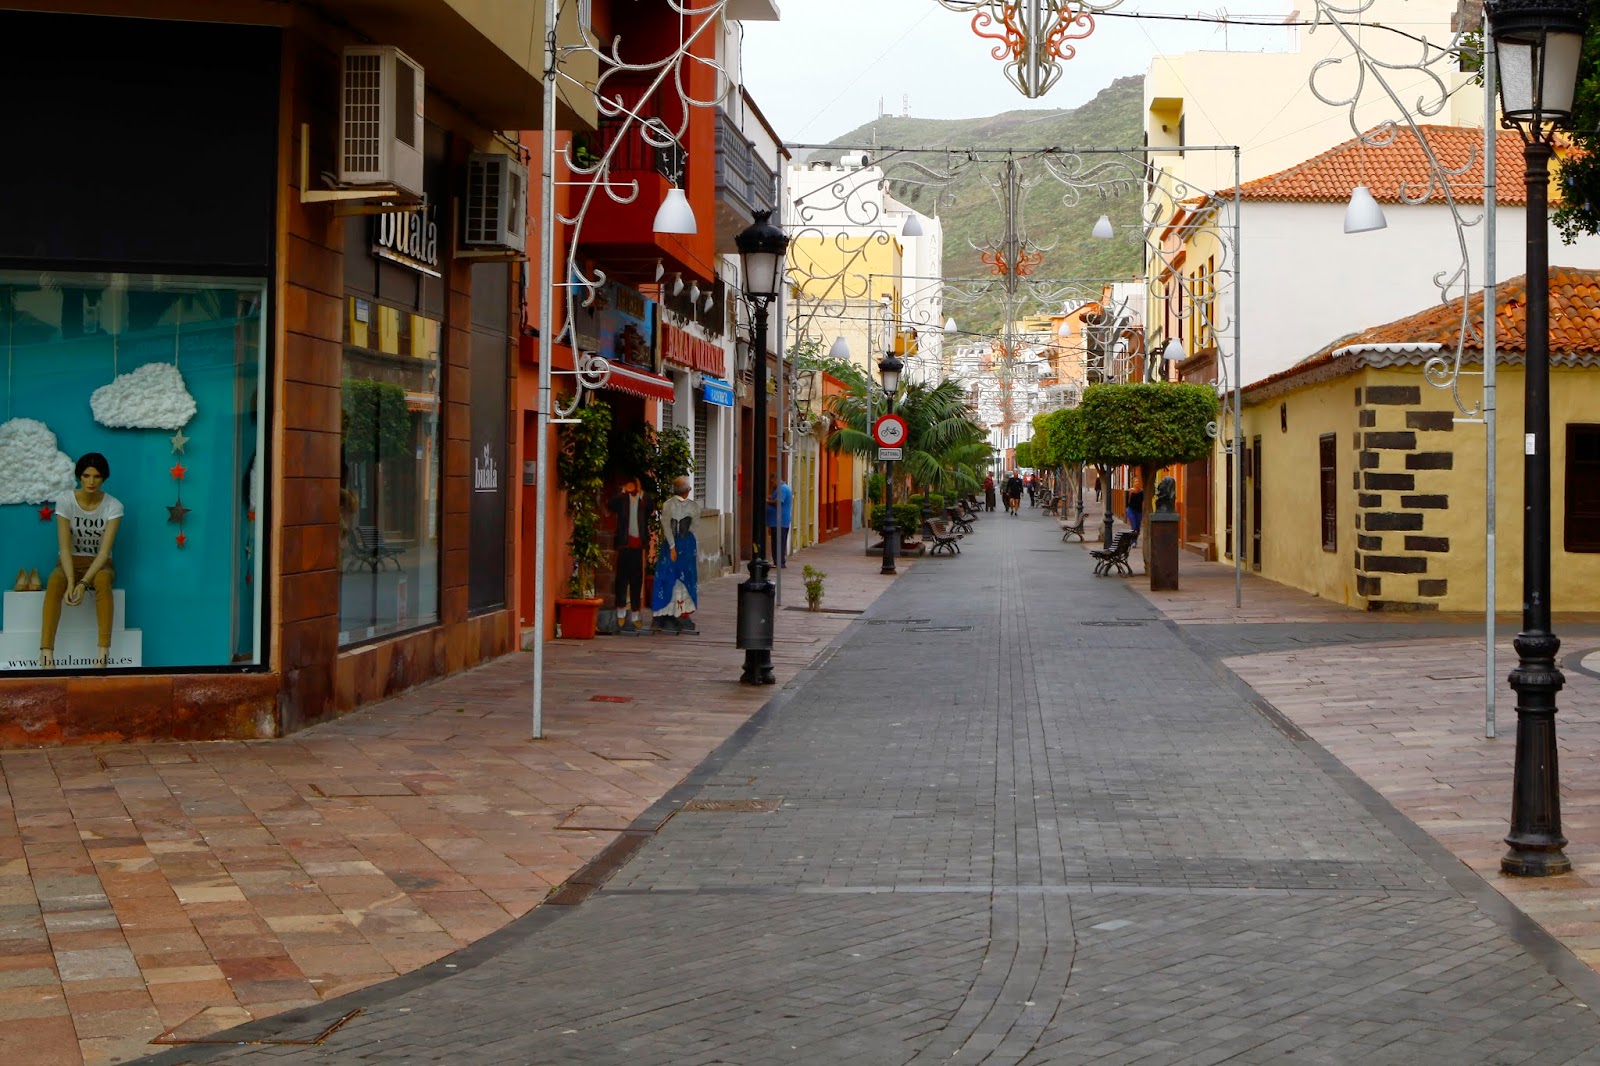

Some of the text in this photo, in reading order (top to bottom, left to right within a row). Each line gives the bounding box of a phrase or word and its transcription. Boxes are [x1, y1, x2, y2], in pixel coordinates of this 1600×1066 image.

[665, 324, 726, 379] BAZAR ORIENTAL
[74, 516, 104, 528] TOO
[70, 528, 106, 537] ASS
[8, 654, 133, 667] www.bualamoda.es
